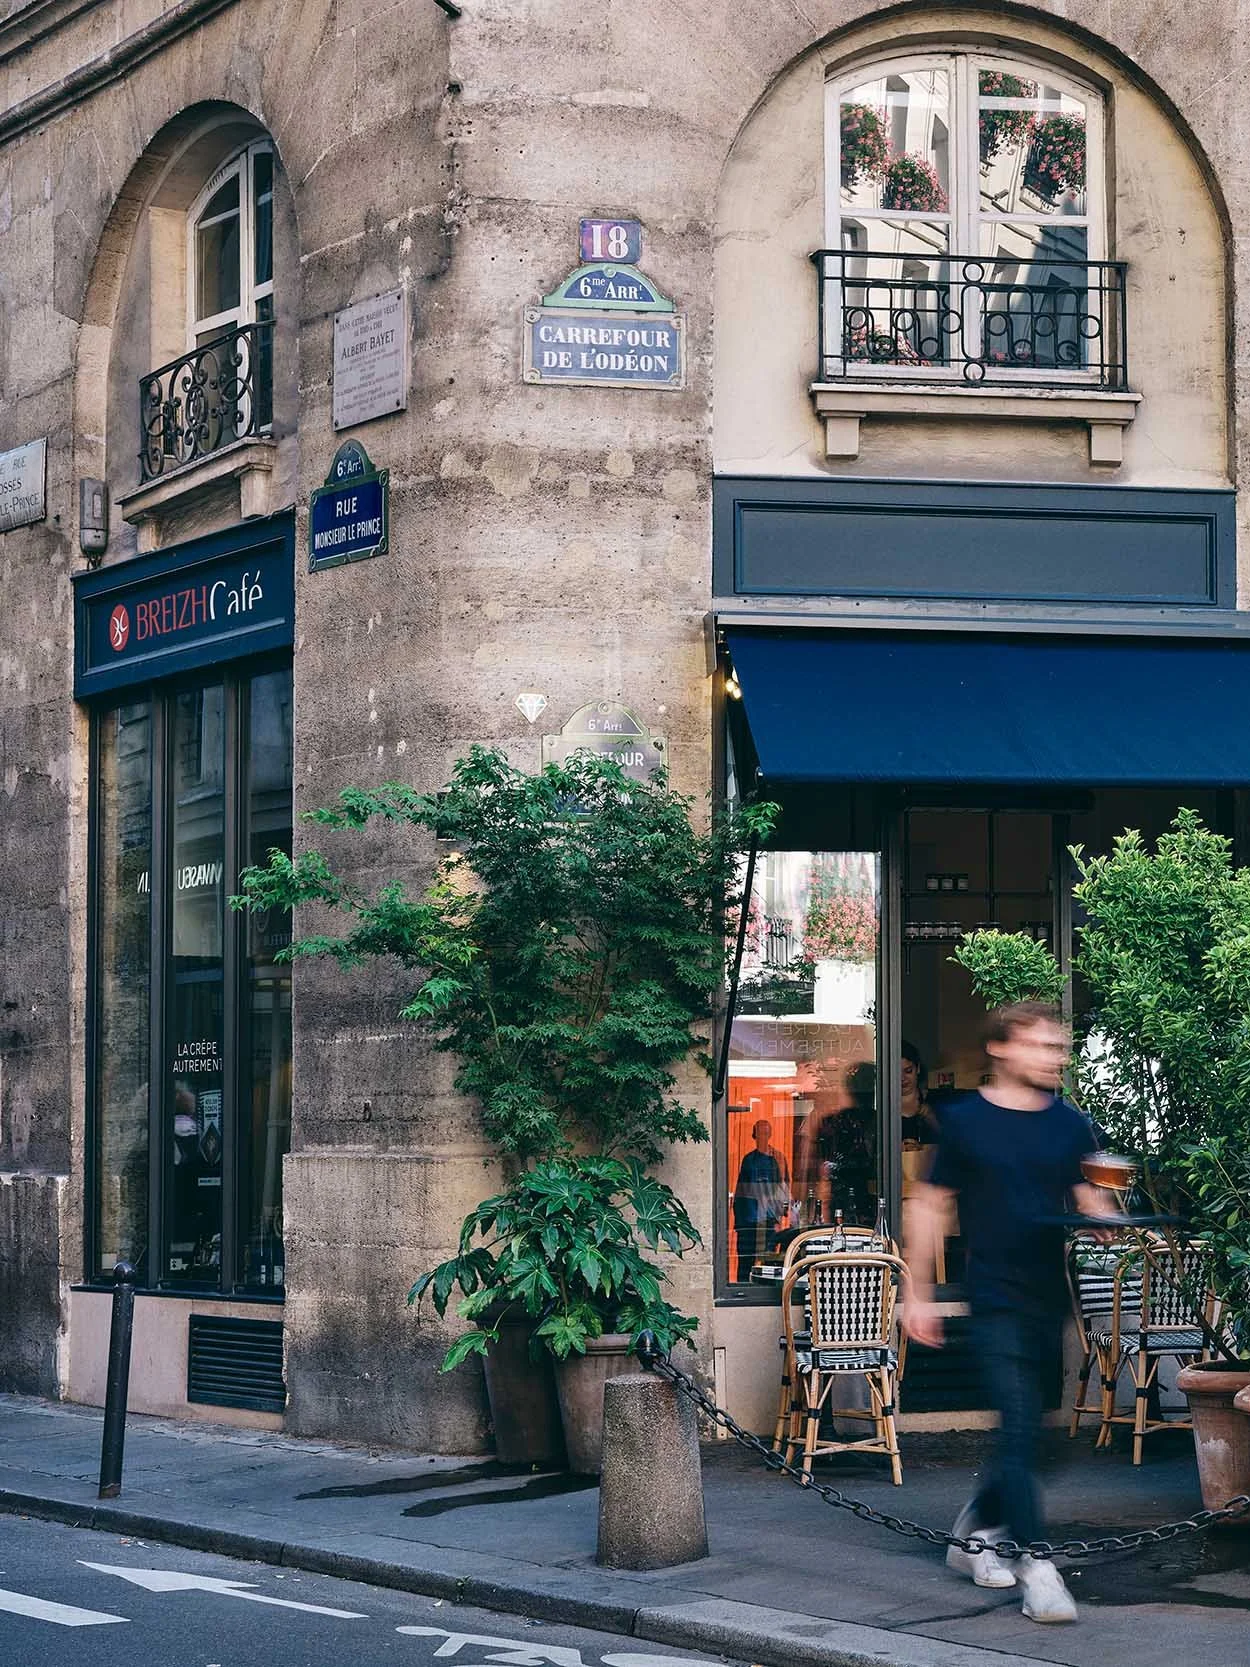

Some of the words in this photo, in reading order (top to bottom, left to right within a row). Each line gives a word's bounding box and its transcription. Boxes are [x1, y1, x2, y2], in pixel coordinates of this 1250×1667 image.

[591, 224, 629, 259] 18
[341, 340, 368, 361] ALBERT
[369, 328, 395, 350] BAYET
[539, 325, 671, 348] CARREFOUR
[543, 350, 572, 368] DE
[580, 348, 669, 372] L'ODÉON
[336, 496, 358, 518] RUE
[314, 525, 347, 550] MONSIEUR
[347, 522, 356, 541] LE
[356, 517, 381, 539] PRINCE
[177, 1042, 189, 1057] LA
[189, 1038, 217, 1056] CRÊPE
[172, 1057, 223, 1073] AUTREMENT
